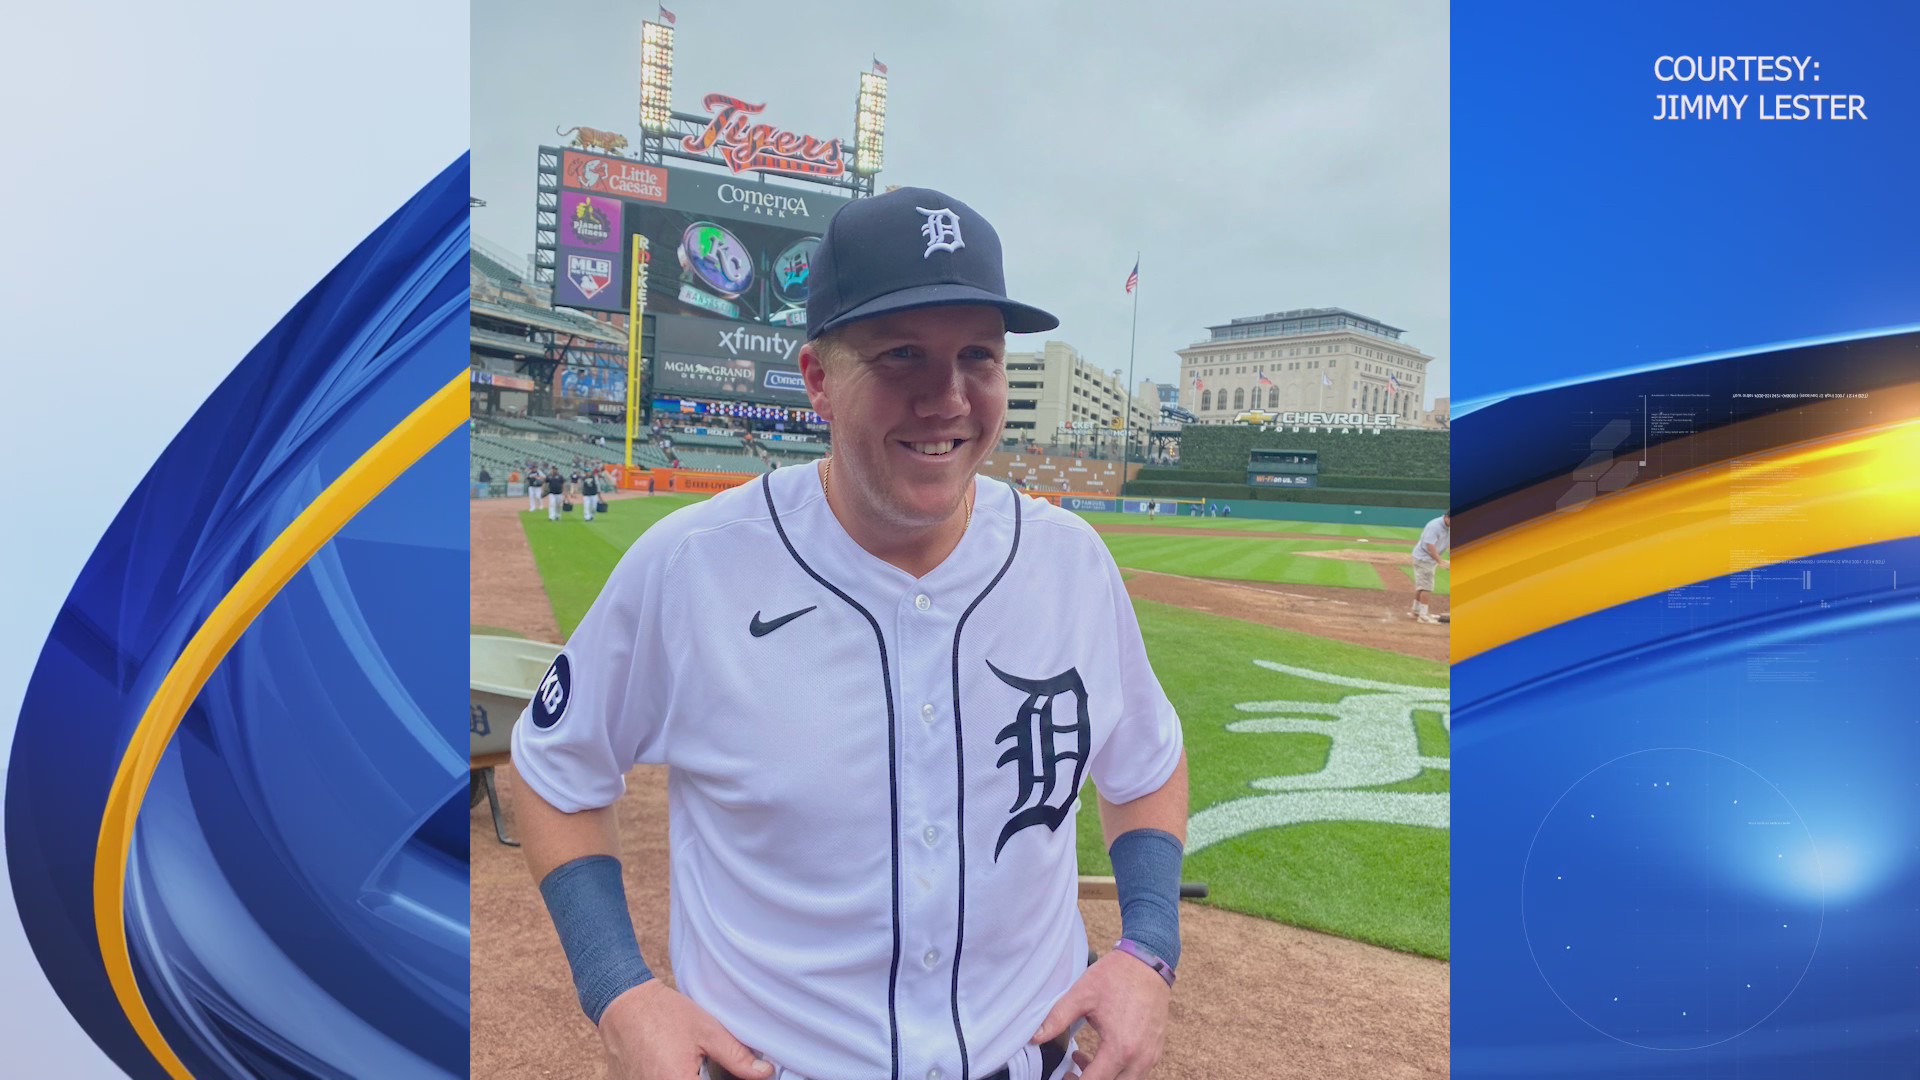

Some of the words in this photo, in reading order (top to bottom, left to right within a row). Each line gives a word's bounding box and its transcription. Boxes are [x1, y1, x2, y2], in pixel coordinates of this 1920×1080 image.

[681, 92, 845, 176] Tigers
[620, 164, 657, 184] Little
[609, 174, 662, 197] Caesars
[743, 204, 786, 218] PARK
[573, 220, 602, 230] planet
[577, 227, 608, 238] fitness
[915, 206, 966, 259] D
[571, 257, 609, 273] MLB
[637, 234, 651, 315] ROCKET
[718, 326, 798, 361] xfinity
[664, 361, 695, 373] MGM
[711, 365, 752, 378] GRAND
[681, 372, 736, 383] DETROIT
[770, 374, 806, 386] Comeri
[1282, 412, 1400, 426] CHEVROLET
[1259, 425, 1381, 435] FOUNTAIN
[1139, 502, 1161, 512] DE
[540, 665, 564, 715] KB
[985, 659, 1091, 864] D
